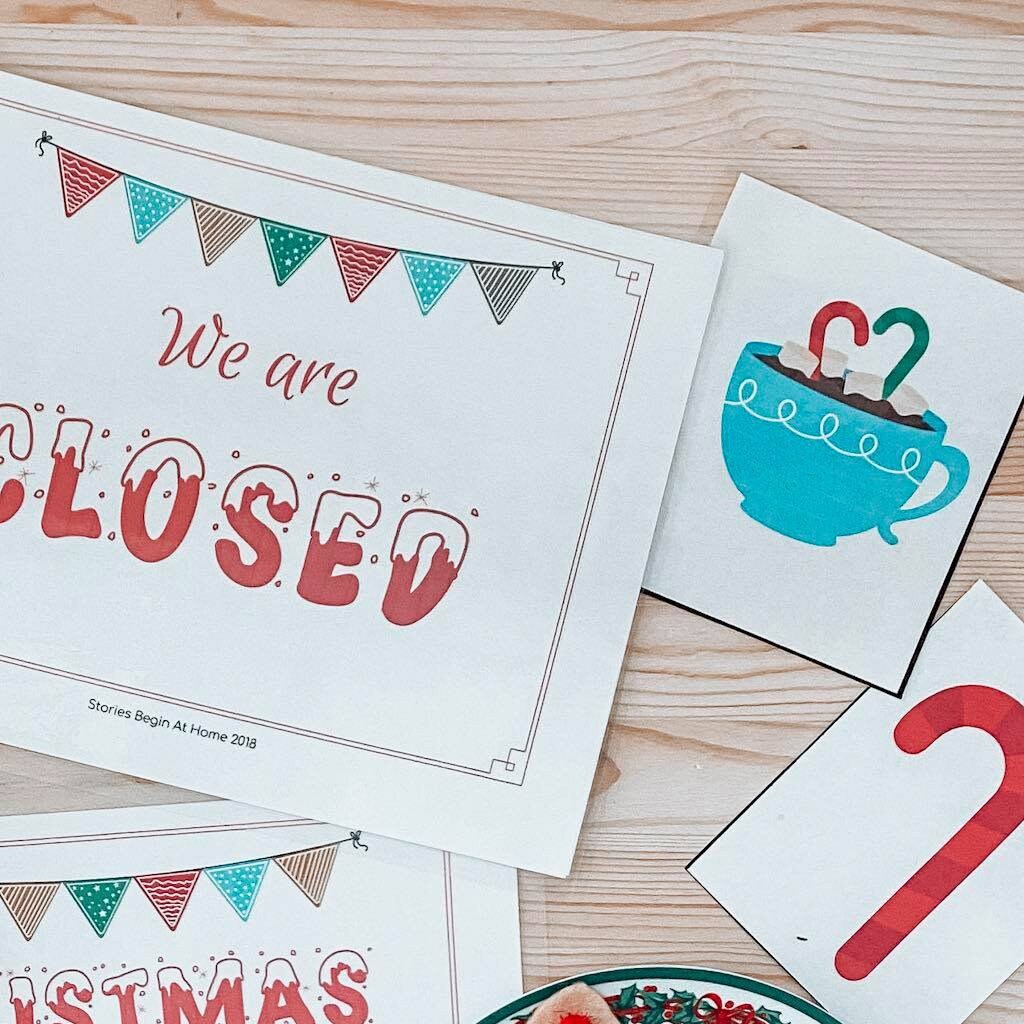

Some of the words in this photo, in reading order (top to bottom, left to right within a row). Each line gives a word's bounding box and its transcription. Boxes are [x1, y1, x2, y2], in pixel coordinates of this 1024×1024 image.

[158, 306, 251, 380] We
[265, 352, 359, 406] are
[87, 698, 132, 719] Stories
[134, 709, 170, 728] Begin
[173, 720, 187, 733] At
[189, 723, 228, 742] Home
[230, 734, 257, 749] 2018
